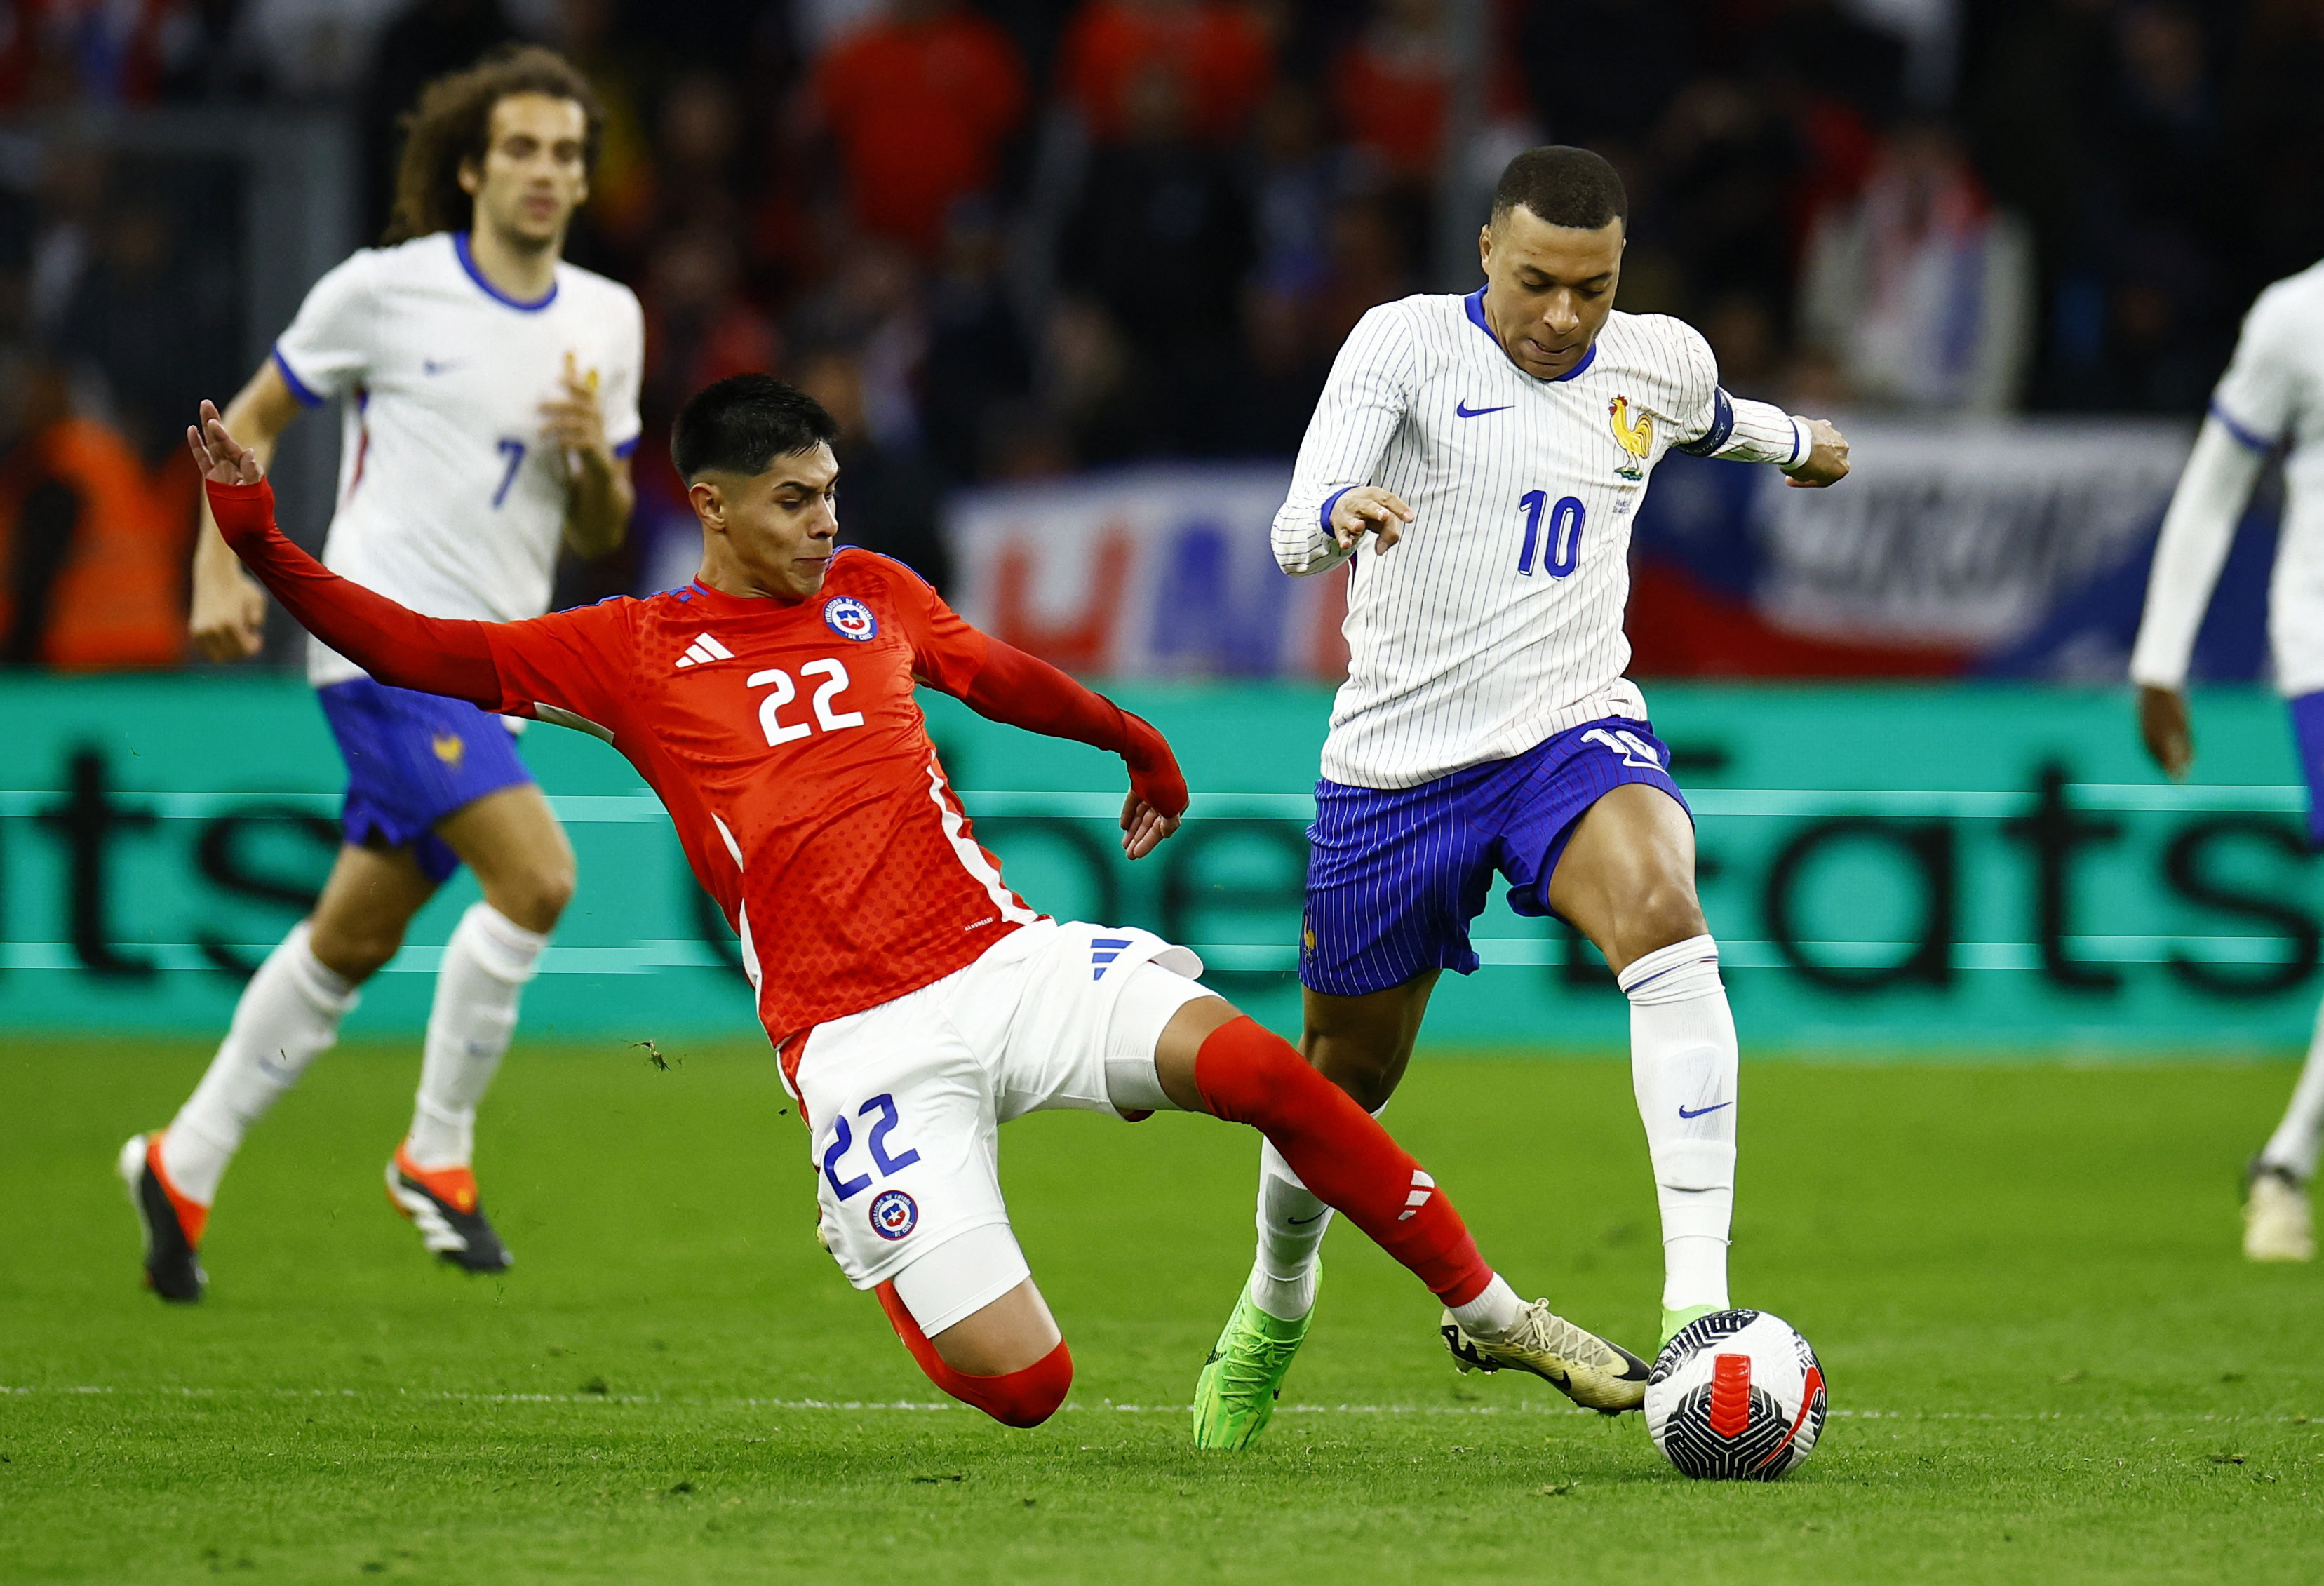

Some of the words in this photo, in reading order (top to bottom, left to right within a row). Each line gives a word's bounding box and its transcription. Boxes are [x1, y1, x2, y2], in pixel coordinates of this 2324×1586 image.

[492, 437, 525, 509] 7
[1518, 489, 1586, 581] 10
[746, 658, 864, 747] 22
[0, 747, 347, 983] ts
[824, 1093, 920, 1202] 22
